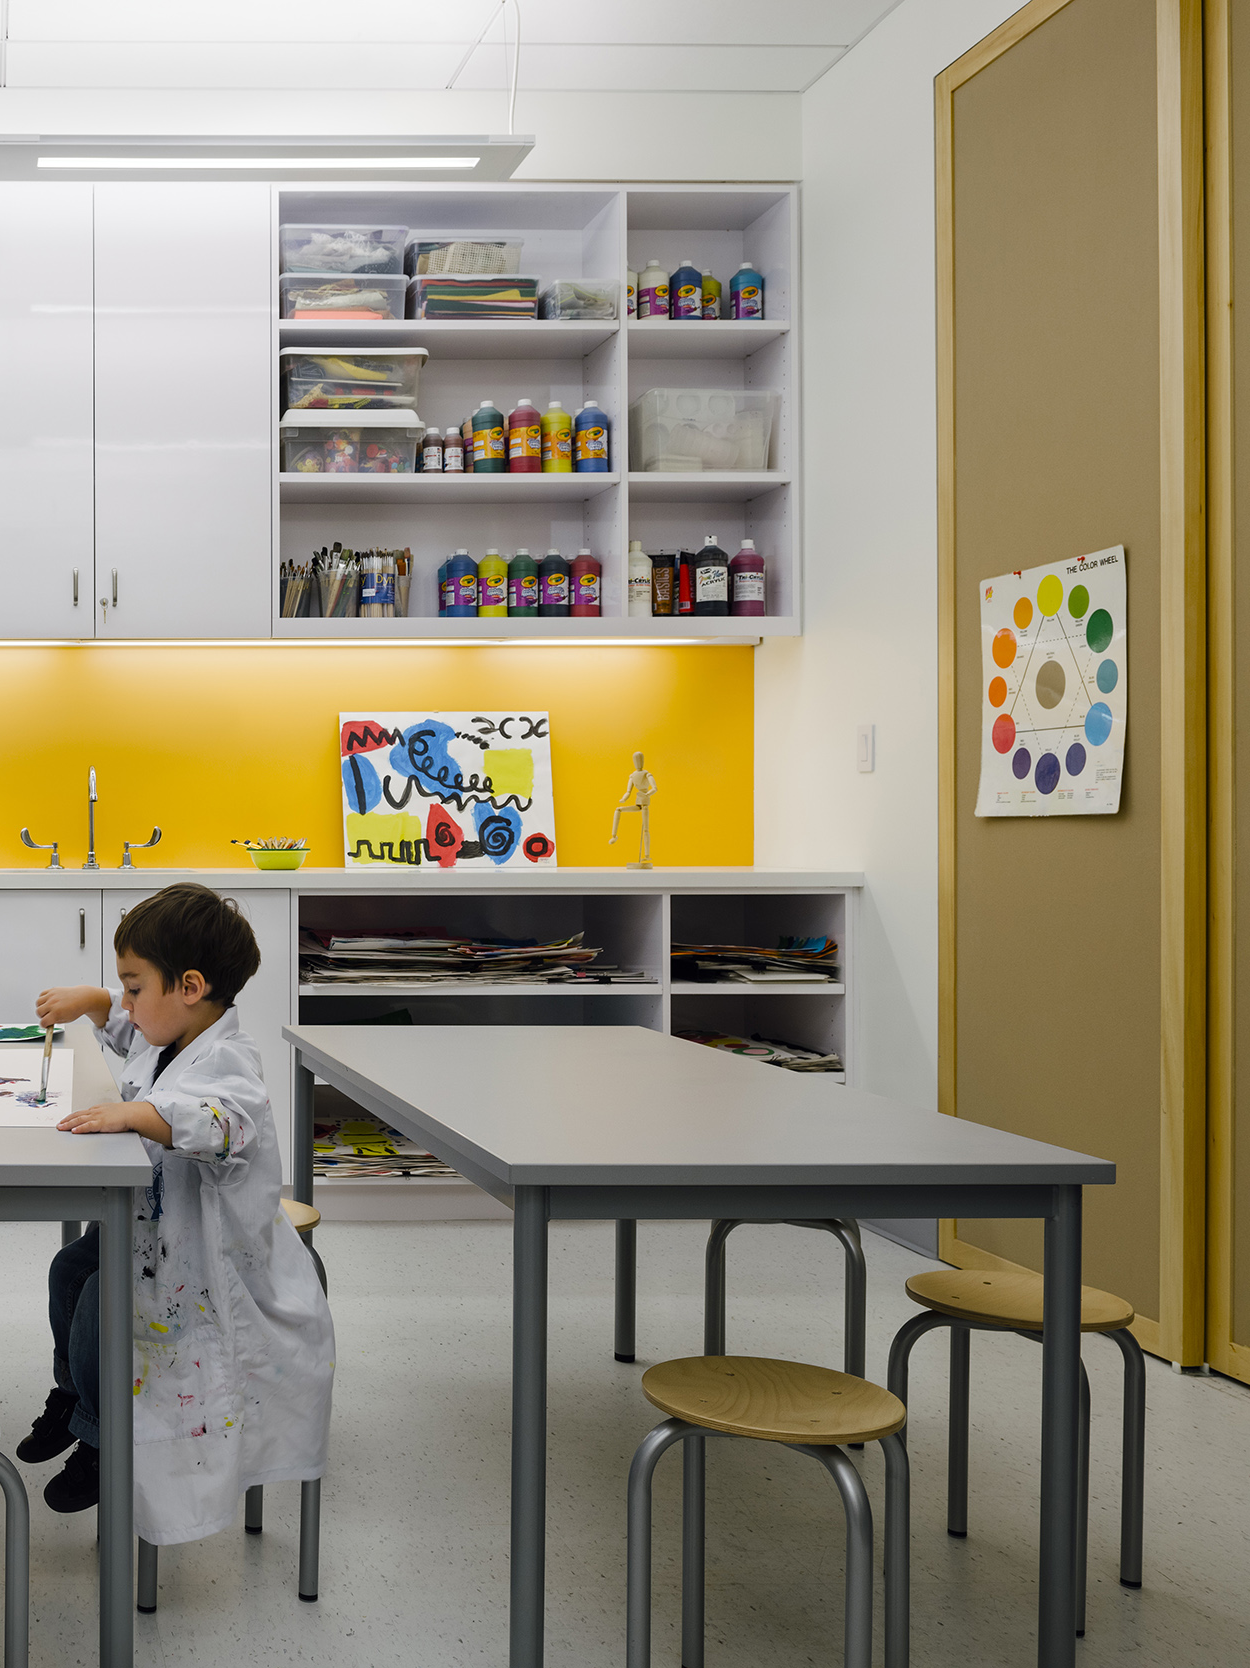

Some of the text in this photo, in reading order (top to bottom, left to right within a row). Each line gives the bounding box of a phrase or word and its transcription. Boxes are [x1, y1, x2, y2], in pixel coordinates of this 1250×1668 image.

[1066, 555, 1118, 575] THE COLOR WHEEL
[656, 567, 670, 601] BASICS
